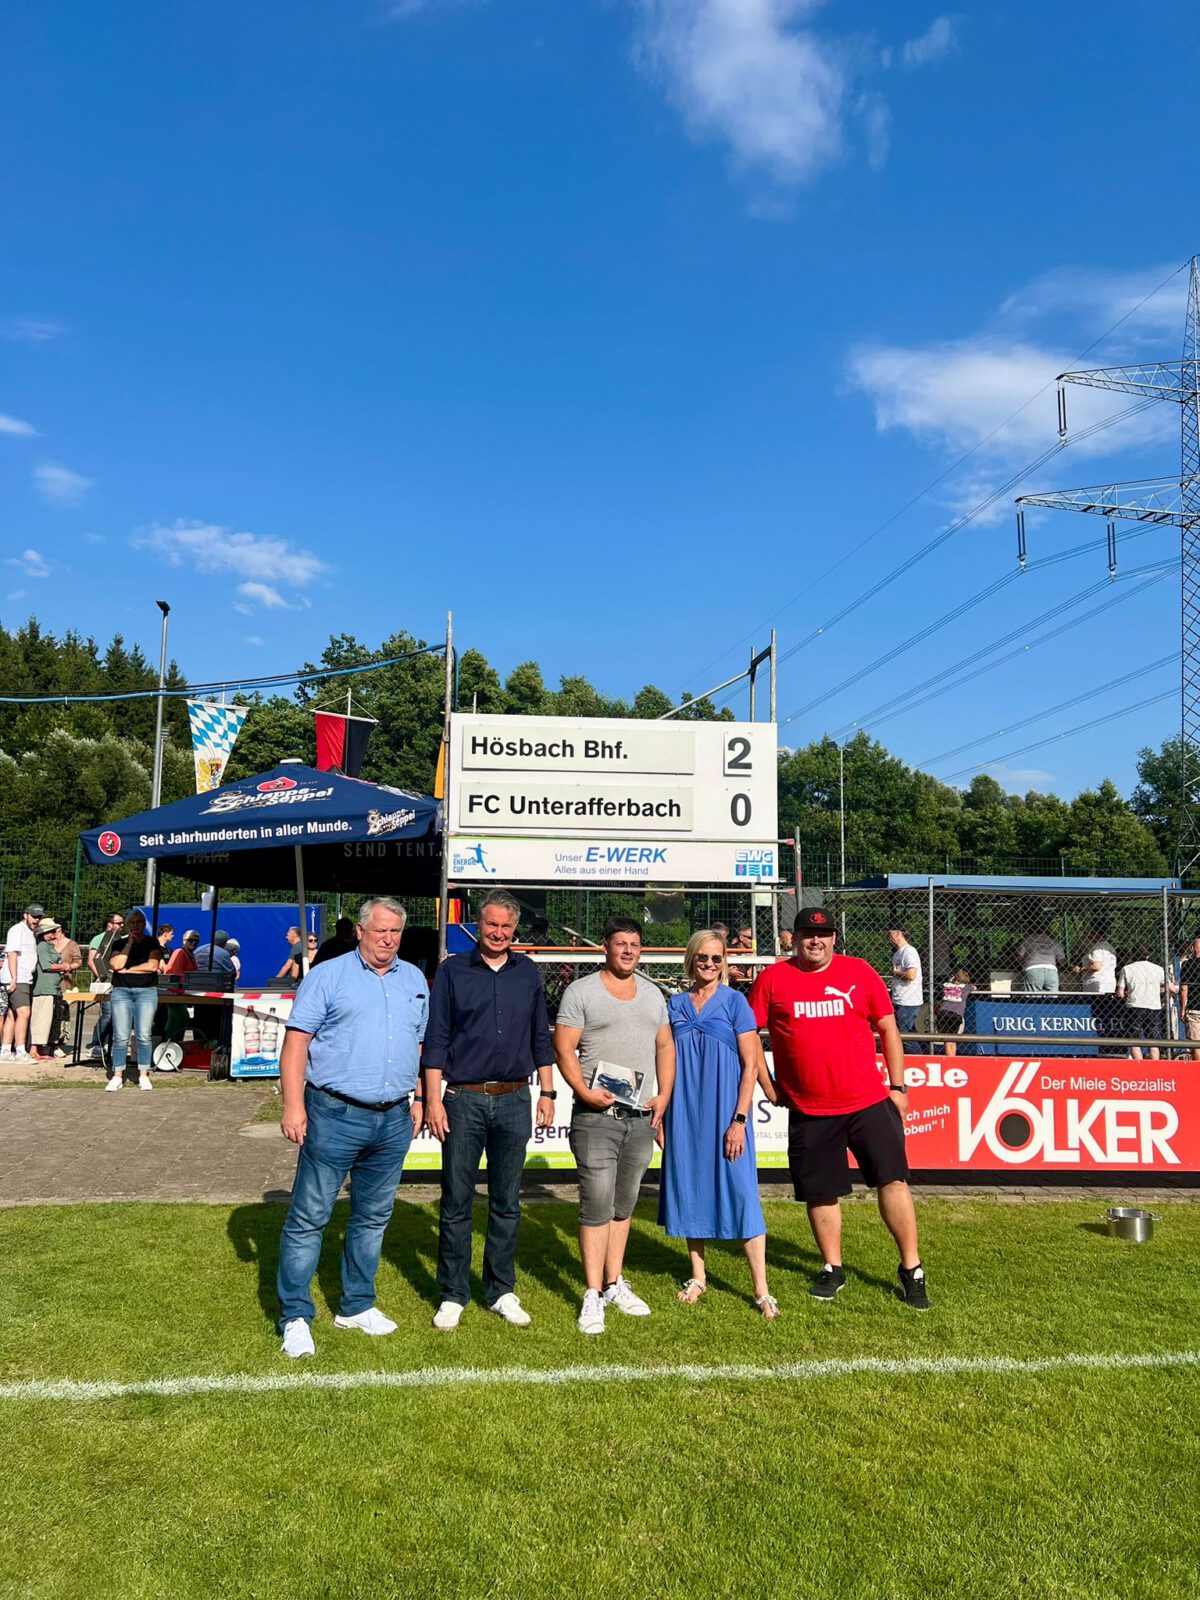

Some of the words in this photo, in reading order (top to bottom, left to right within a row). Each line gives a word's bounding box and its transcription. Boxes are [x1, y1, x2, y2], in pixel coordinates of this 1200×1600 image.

[471, 735, 575, 758] Hösbach
[583, 739, 628, 760] Bhf.
[727, 737, 753, 770] 2
[468, 794, 501, 815] FC
[509, 795, 682, 818] Unterafferbach
[730, 792, 752, 827] 0
[139, 834, 164, 847] Seit
[167, 828, 258, 845] Jahrhunderten
[260, 826, 273, 838] in
[275, 823, 304, 837] aller
[307, 819, 353, 834] Munde.
[554, 853, 583, 863] Unser
[585, 846, 668, 863] E-WERK
[735, 849, 773, 863] EWG
[554, 865, 578, 875] Alles
[579, 867, 597, 875] aus
[598, 866, 623, 875] einer
[624, 866, 649, 875] Hand
[793, 999, 845, 1018] PUMA
[992, 1016, 1037, 1033] URIG,
[1041, 1076, 1067, 1090] Der
[1069, 1077, 1107, 1091] Miele
[1111, 1077, 1177, 1094] Spezialist
[923, 1104, 951, 1118] mich
[957, 1061, 1181, 1164] VÖLKER
[754, 1131, 772, 1139] ITAL
[774, 1131, 788, 1139] SER
